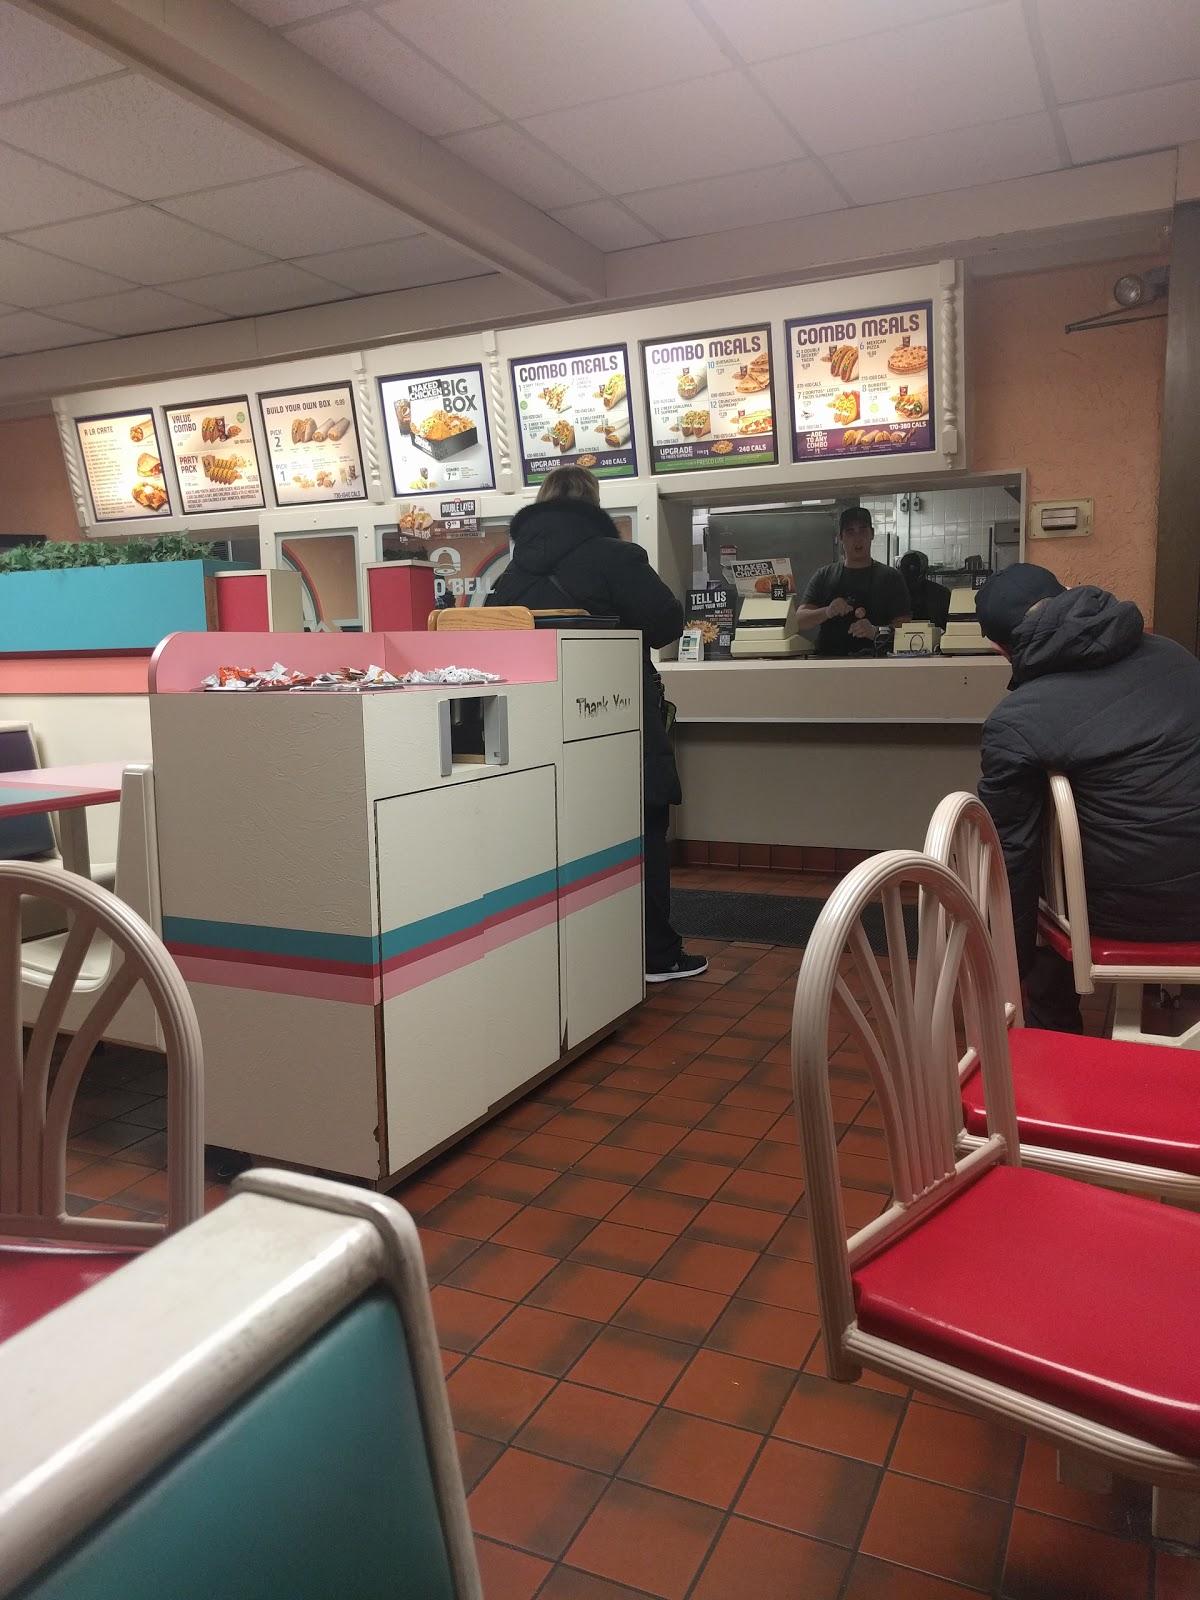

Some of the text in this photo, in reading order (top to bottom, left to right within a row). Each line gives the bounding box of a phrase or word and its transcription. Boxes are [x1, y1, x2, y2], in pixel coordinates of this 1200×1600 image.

[798, 314, 920, 346] COMBO MEALS
[652, 336, 761, 365] COMBO MEALS
[860, 342, 864, 350] 6
[519, 363, 567, 383] COMBO
[572, 355, 618, 376] MEALS
[411, 381, 439, 392] NAKED
[440, 379, 468, 397] BIG
[410, 388, 442, 400] CHICKEN
[266, 407, 284, 415] BUILD
[285, 403, 301, 412] YOUR
[302, 401, 318, 410] OWN
[318, 400, 331, 408] BOX
[442, 395, 478, 413] BOX
[172, 414, 192, 424] VALUE
[96, 426, 114, 435] CARTE
[174, 423, 197, 433] COMBO
[274, 437, 281, 447] 2
[660, 446, 693, 456] UPGRADE
[179, 455, 199, 465] PARTY
[530, 459, 561, 469] UPGRADE
[181, 464, 198, 474] PACK
[441, 502, 475, 513] DOUBLE LAYER
[736, 562, 769, 572] NAKED
[735, 568, 776, 578] CHICKEN
[691, 591, 727, 605] TELL US
[576, 695, 609, 715] Thank
